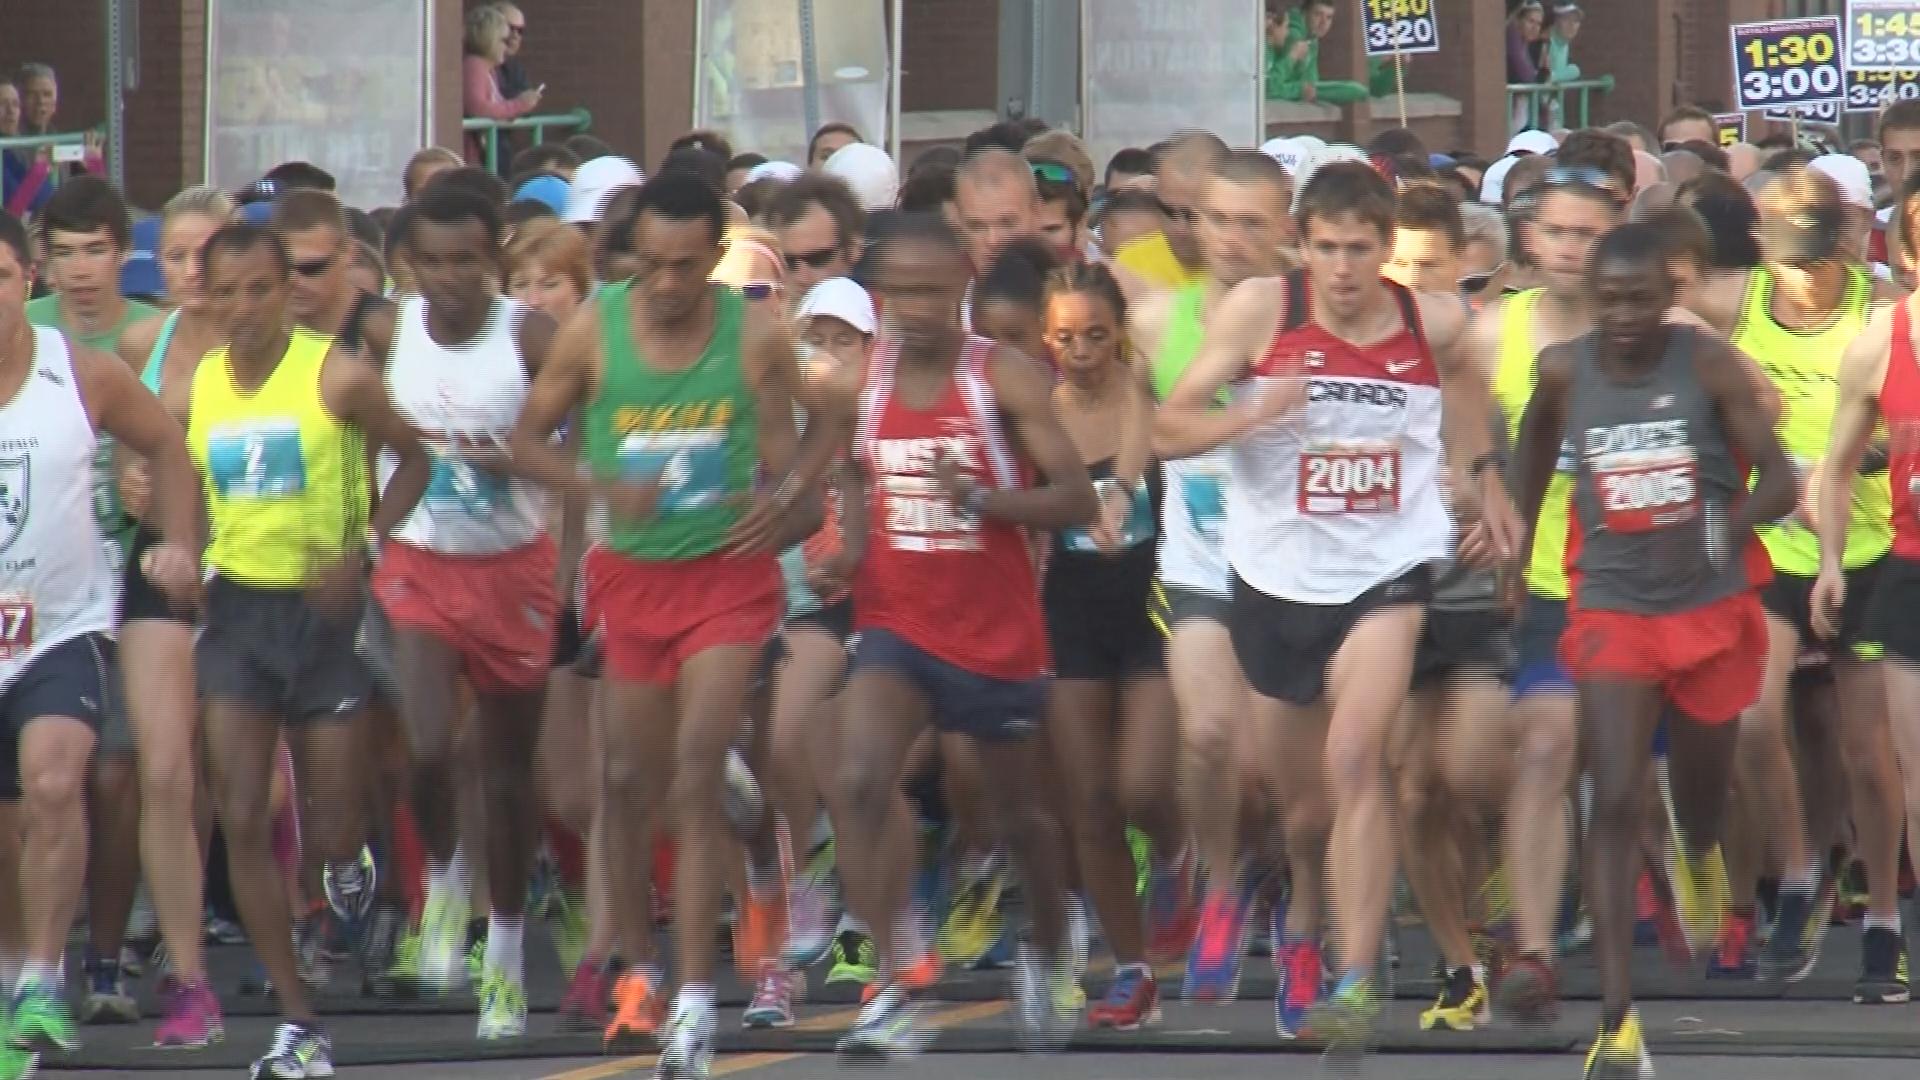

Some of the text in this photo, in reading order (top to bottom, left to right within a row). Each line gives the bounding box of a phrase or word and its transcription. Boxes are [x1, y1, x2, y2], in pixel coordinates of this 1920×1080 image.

[1369, 18, 1433, 47] 3:20
[1744, 33, 1834, 68] 1:30
[1744, 65, 1839, 100] 3:00
[1307, 380, 1408, 411] CANADA
[244, 433, 266, 483] 2
[657, 449, 694, 494] 4
[1304, 455, 1397, 495] 2004
[1602, 467, 1698, 512] 2005
